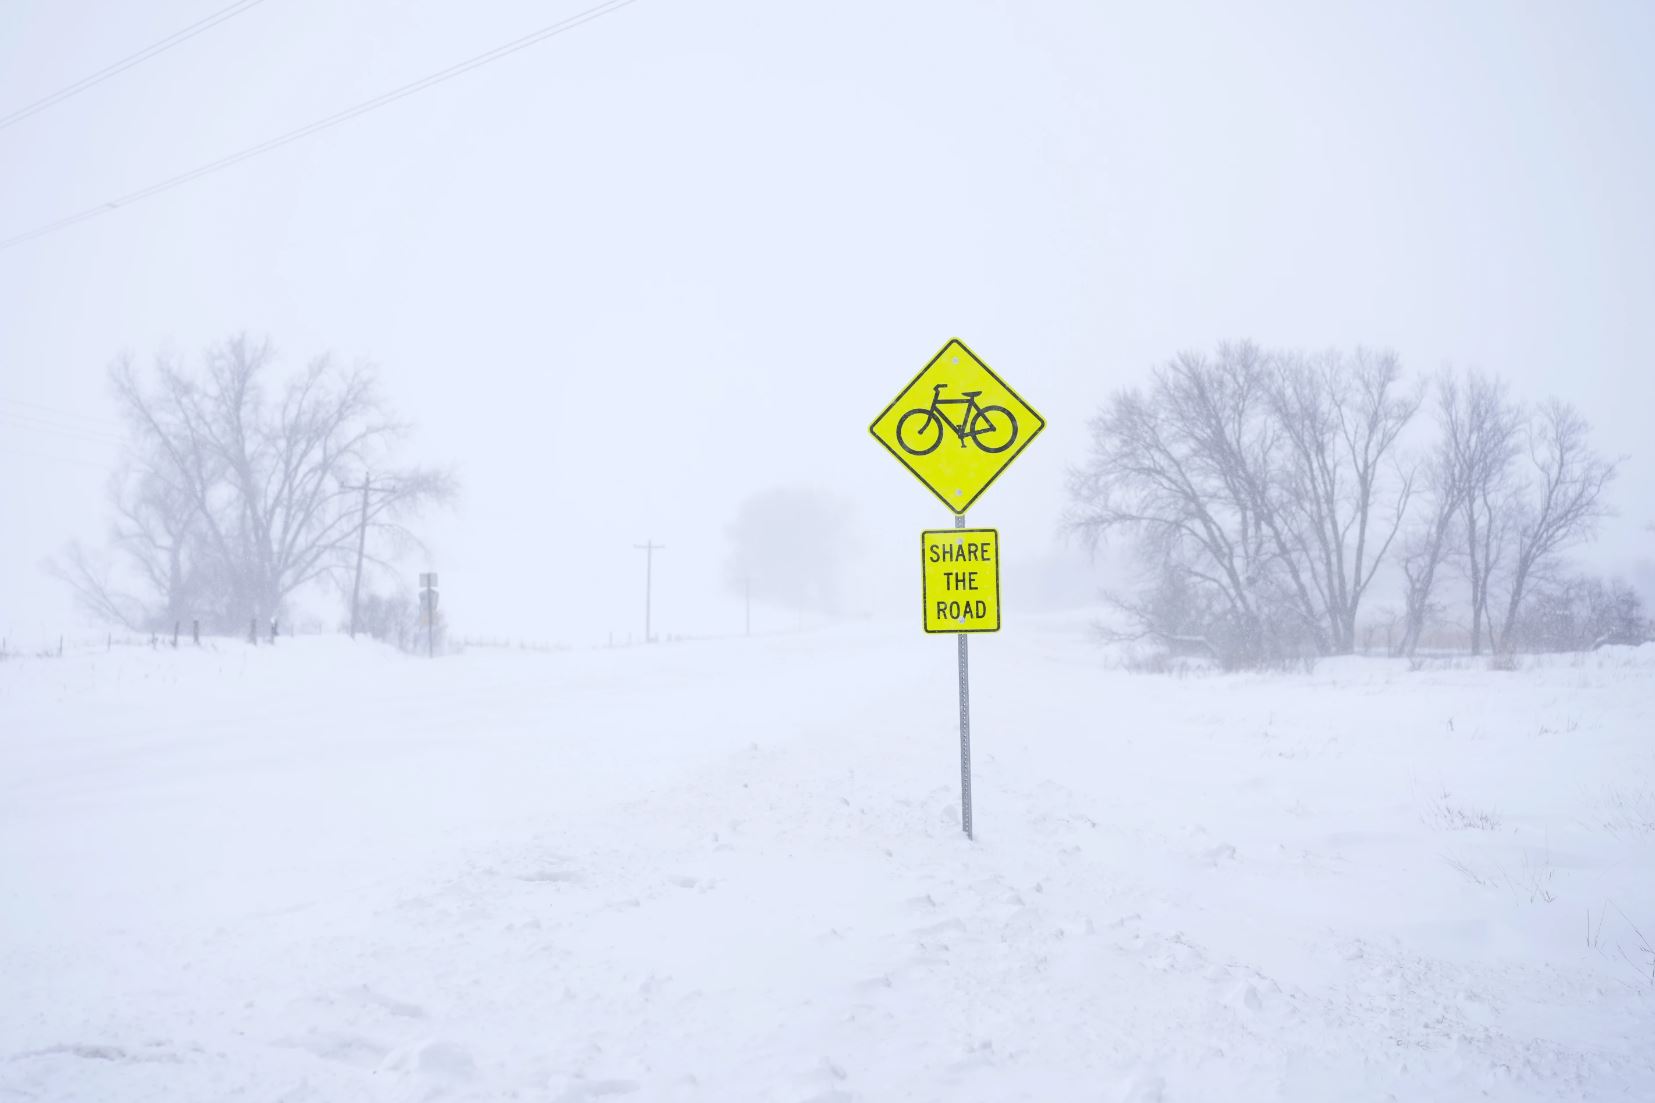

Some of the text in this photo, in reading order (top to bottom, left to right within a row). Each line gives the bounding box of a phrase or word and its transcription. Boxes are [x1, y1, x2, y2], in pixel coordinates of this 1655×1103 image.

[929, 542, 991, 562] SHARE
[943, 572, 978, 590] THE
[936, 600, 986, 619] ROAD
